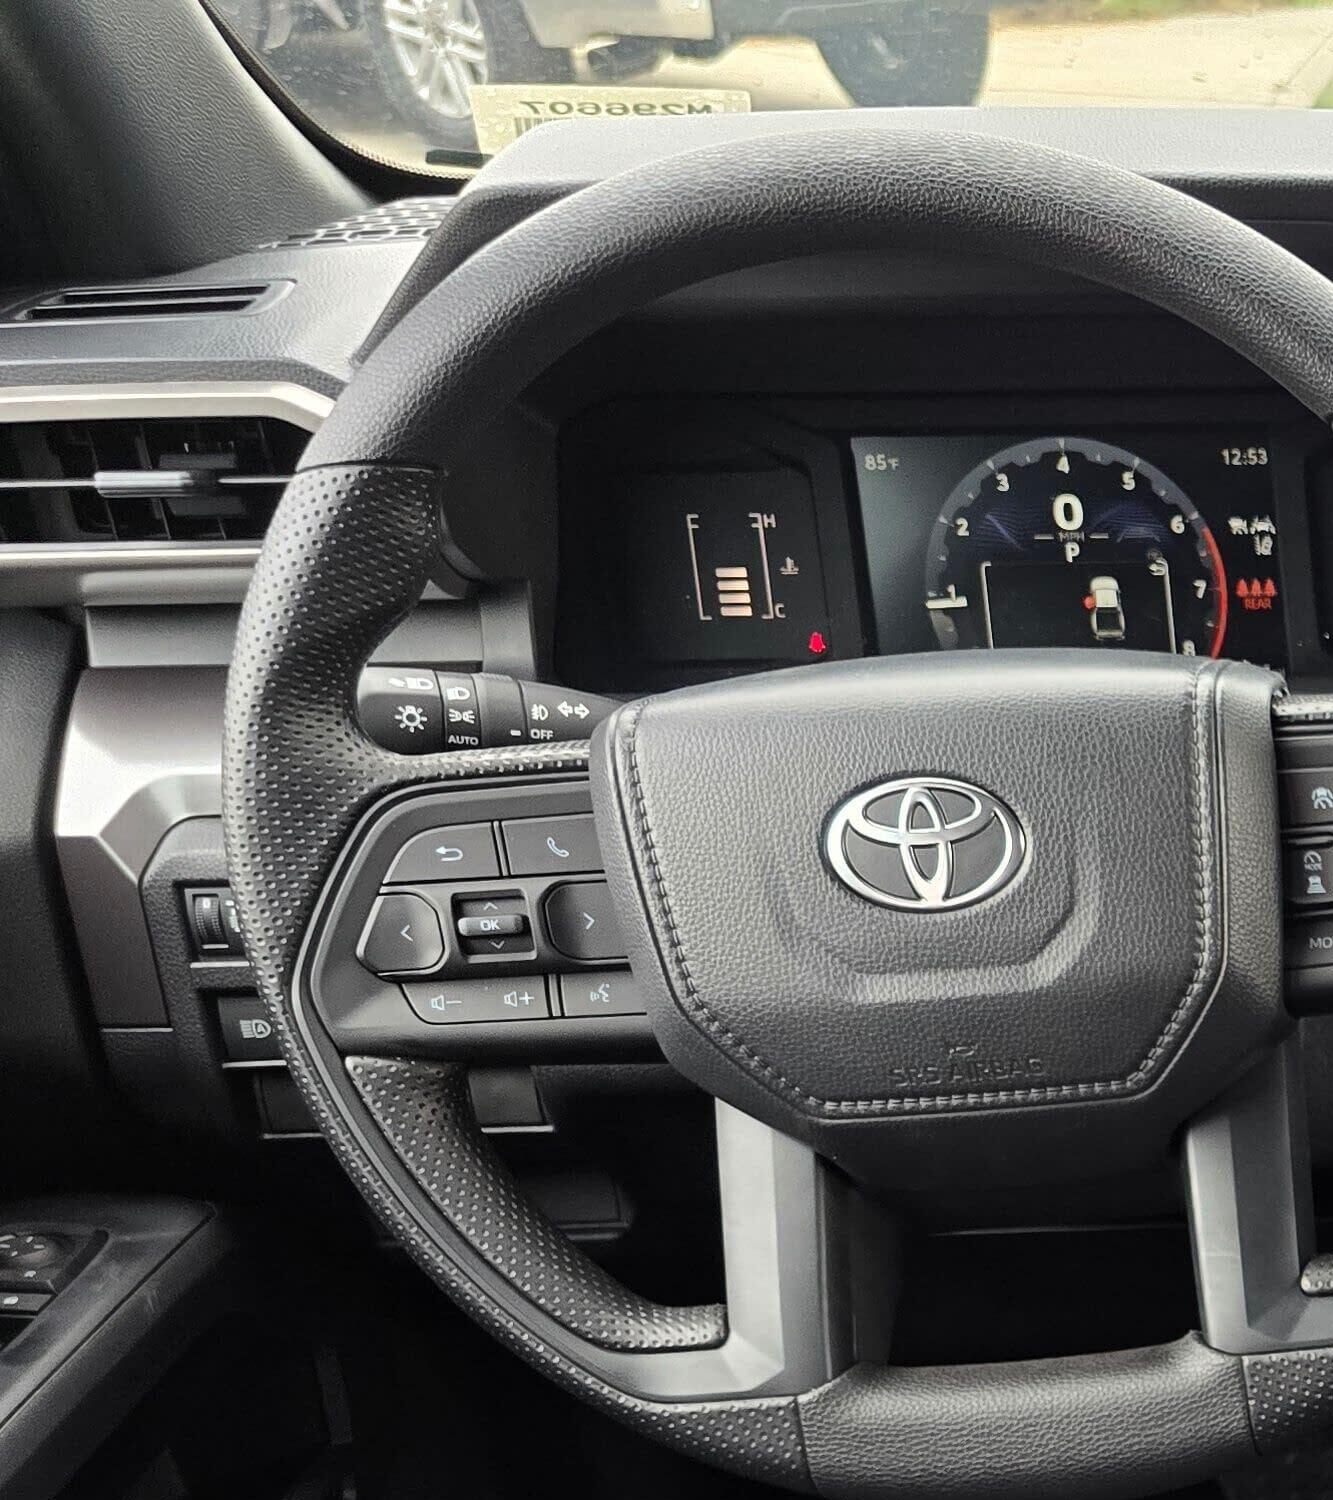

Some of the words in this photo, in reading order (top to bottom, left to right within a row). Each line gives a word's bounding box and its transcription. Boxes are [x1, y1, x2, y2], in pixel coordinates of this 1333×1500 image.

[1056, 455, 1070, 474] 4
[1221, 447, 1268, 466] 12:53
[996, 473, 1010, 491] 3
[1121, 471, 1135, 491] 5
[763, 514, 776, 528] H
[1052, 493, 1084, 531] 0
[955, 517, 970, 536] 2
[1170, 515, 1185, 534] 6
[1065, 541, 1080, 563] P
[1193, 579, 1207, 599] 7
[775, 603, 786, 618] C
[1244, 598, 1272, 610] REAR
[448, 734, 479, 746] AUTO
[530, 729, 554, 741] OFF
[480, 918, 500, 931] OK
